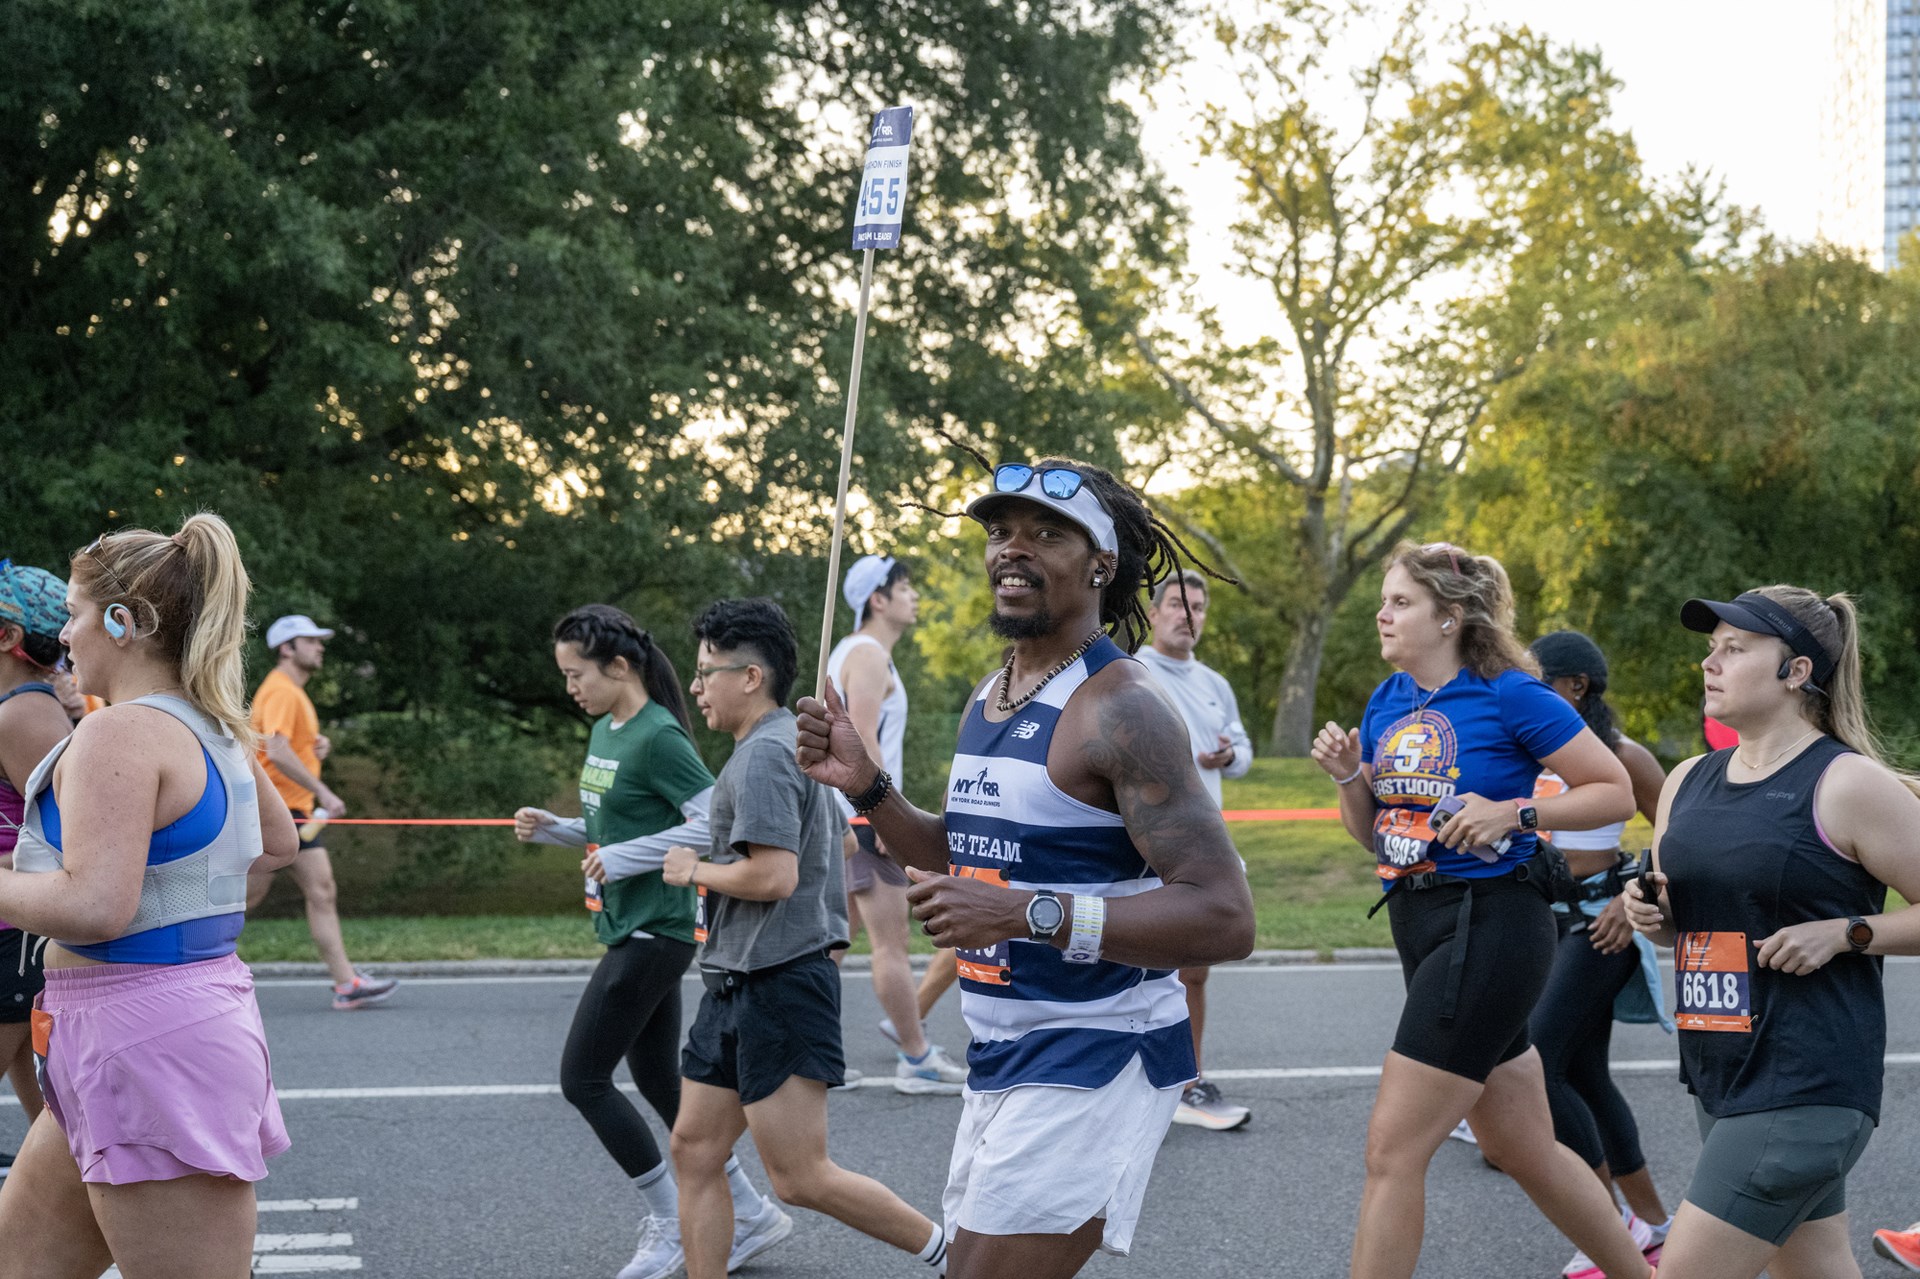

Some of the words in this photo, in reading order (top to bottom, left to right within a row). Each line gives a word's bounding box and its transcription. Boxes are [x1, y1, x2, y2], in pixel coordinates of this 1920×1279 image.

[883, 159, 902, 168] FINISH
[1767, 611, 1793, 632] KIPRUN
[1372, 778, 1456, 798] EASTWOOD
[970, 798, 983, 806] ROAD
[983, 800, 1001, 808] RUNNERS
[947, 831, 965, 853] CE
[968, 834, 1022, 863] TEAM
[1384, 834, 1421, 866] 4803
[1683, 972, 1739, 1009] 6618
